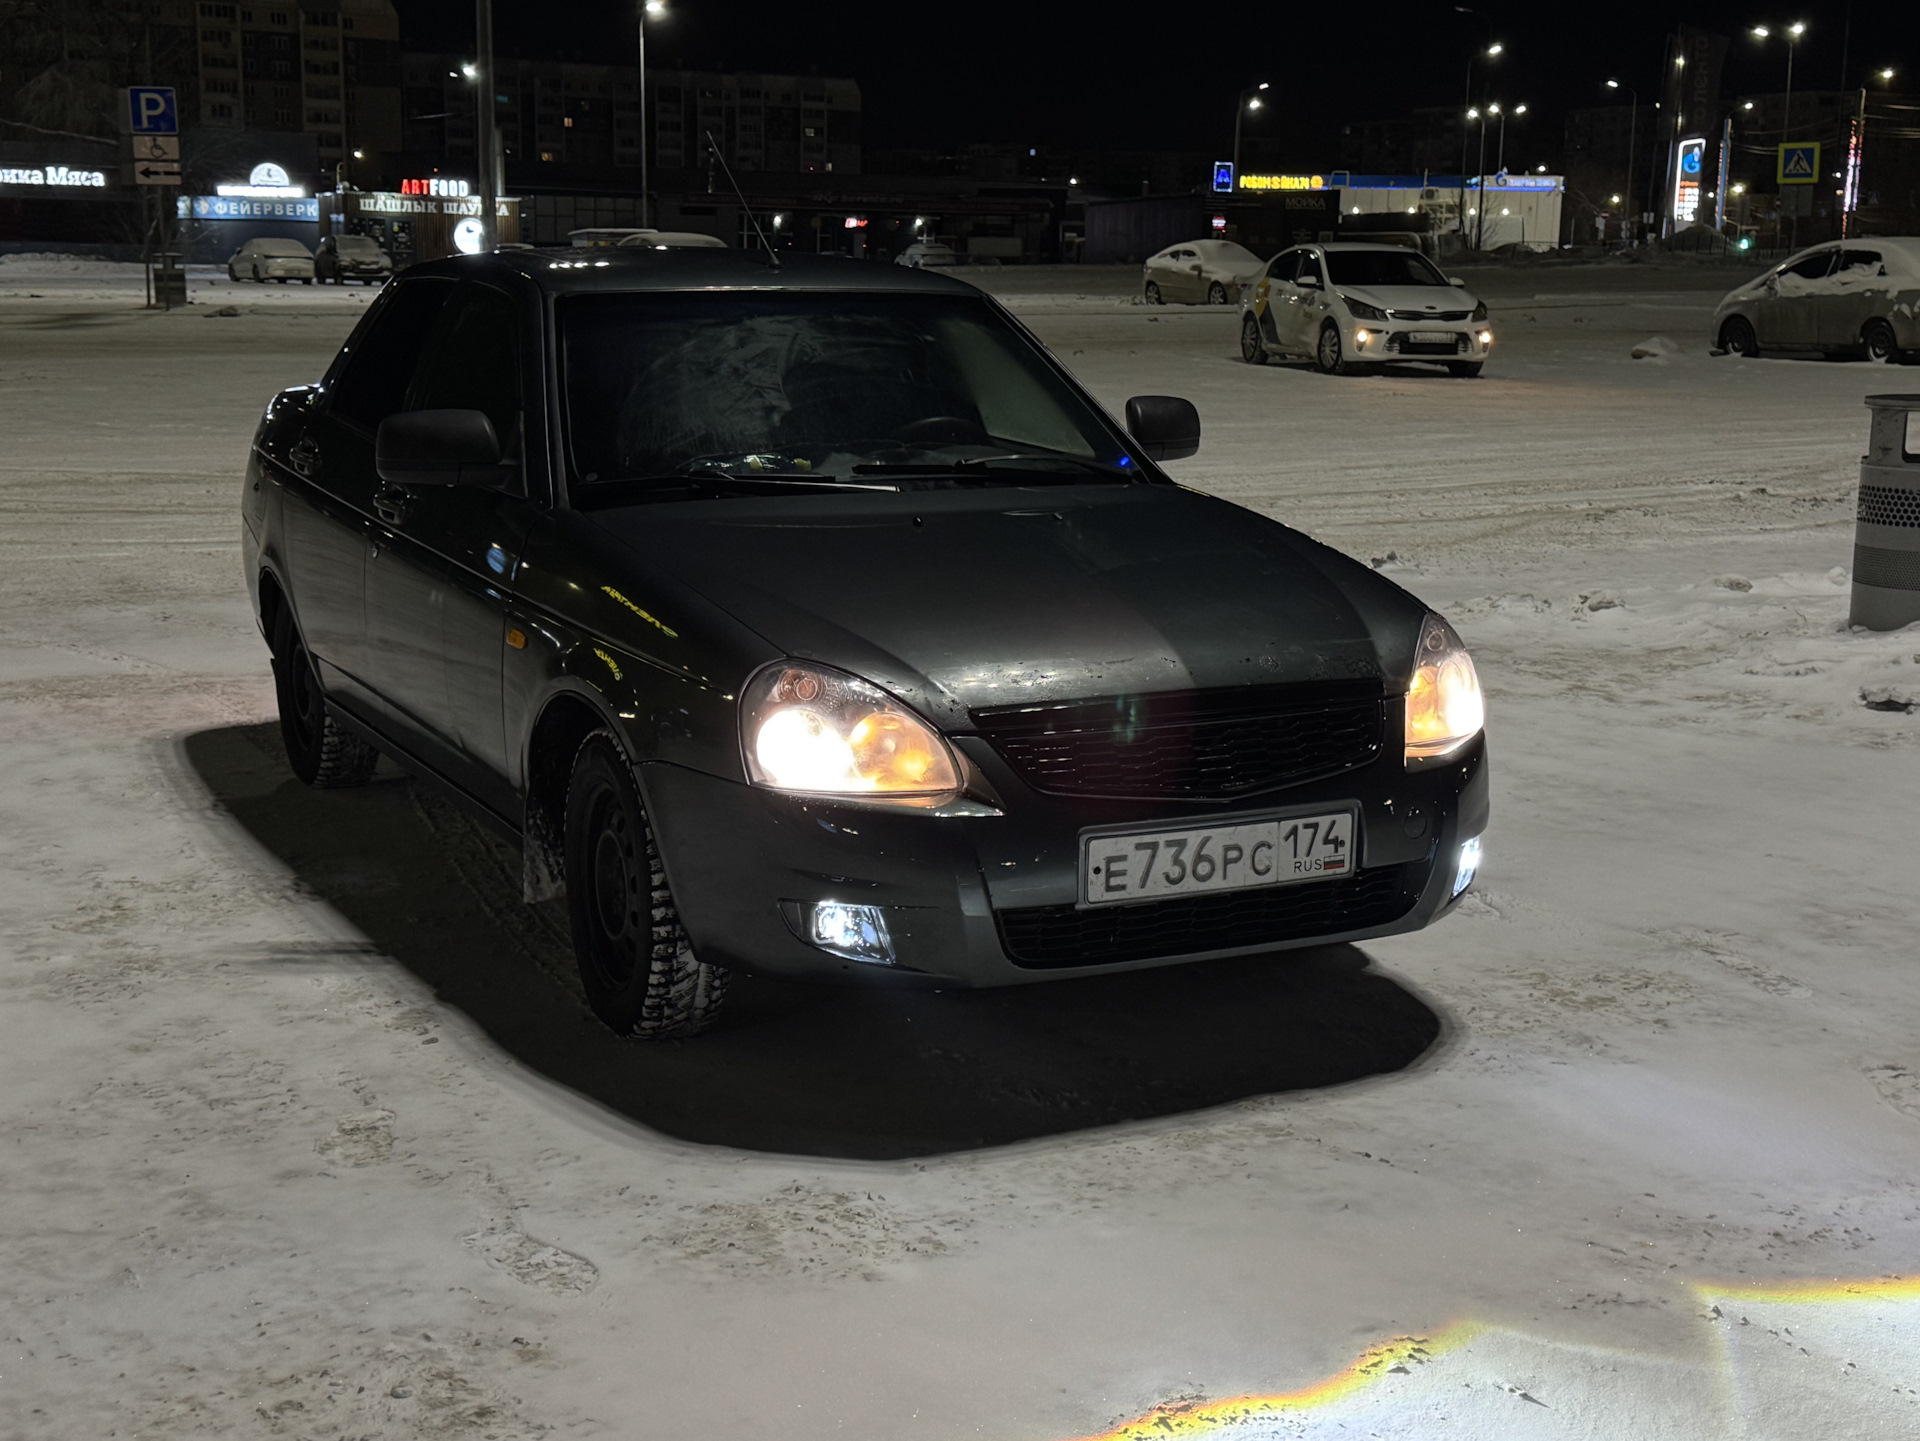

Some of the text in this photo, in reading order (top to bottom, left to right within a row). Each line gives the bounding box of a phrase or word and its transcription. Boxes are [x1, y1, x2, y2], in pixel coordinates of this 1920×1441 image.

[139, 92, 166, 129] P
[46, 166, 105, 187] Мяса
[401, 178, 469, 198] ARTFOOD
[214, 200, 317, 217] ФЕЙЕРВЕРК
[359, 198, 510, 216] ШАШЛЫК ШАУА
[1283, 819, 1339, 858] 174
[1293, 858, 1322, 873] RUS
